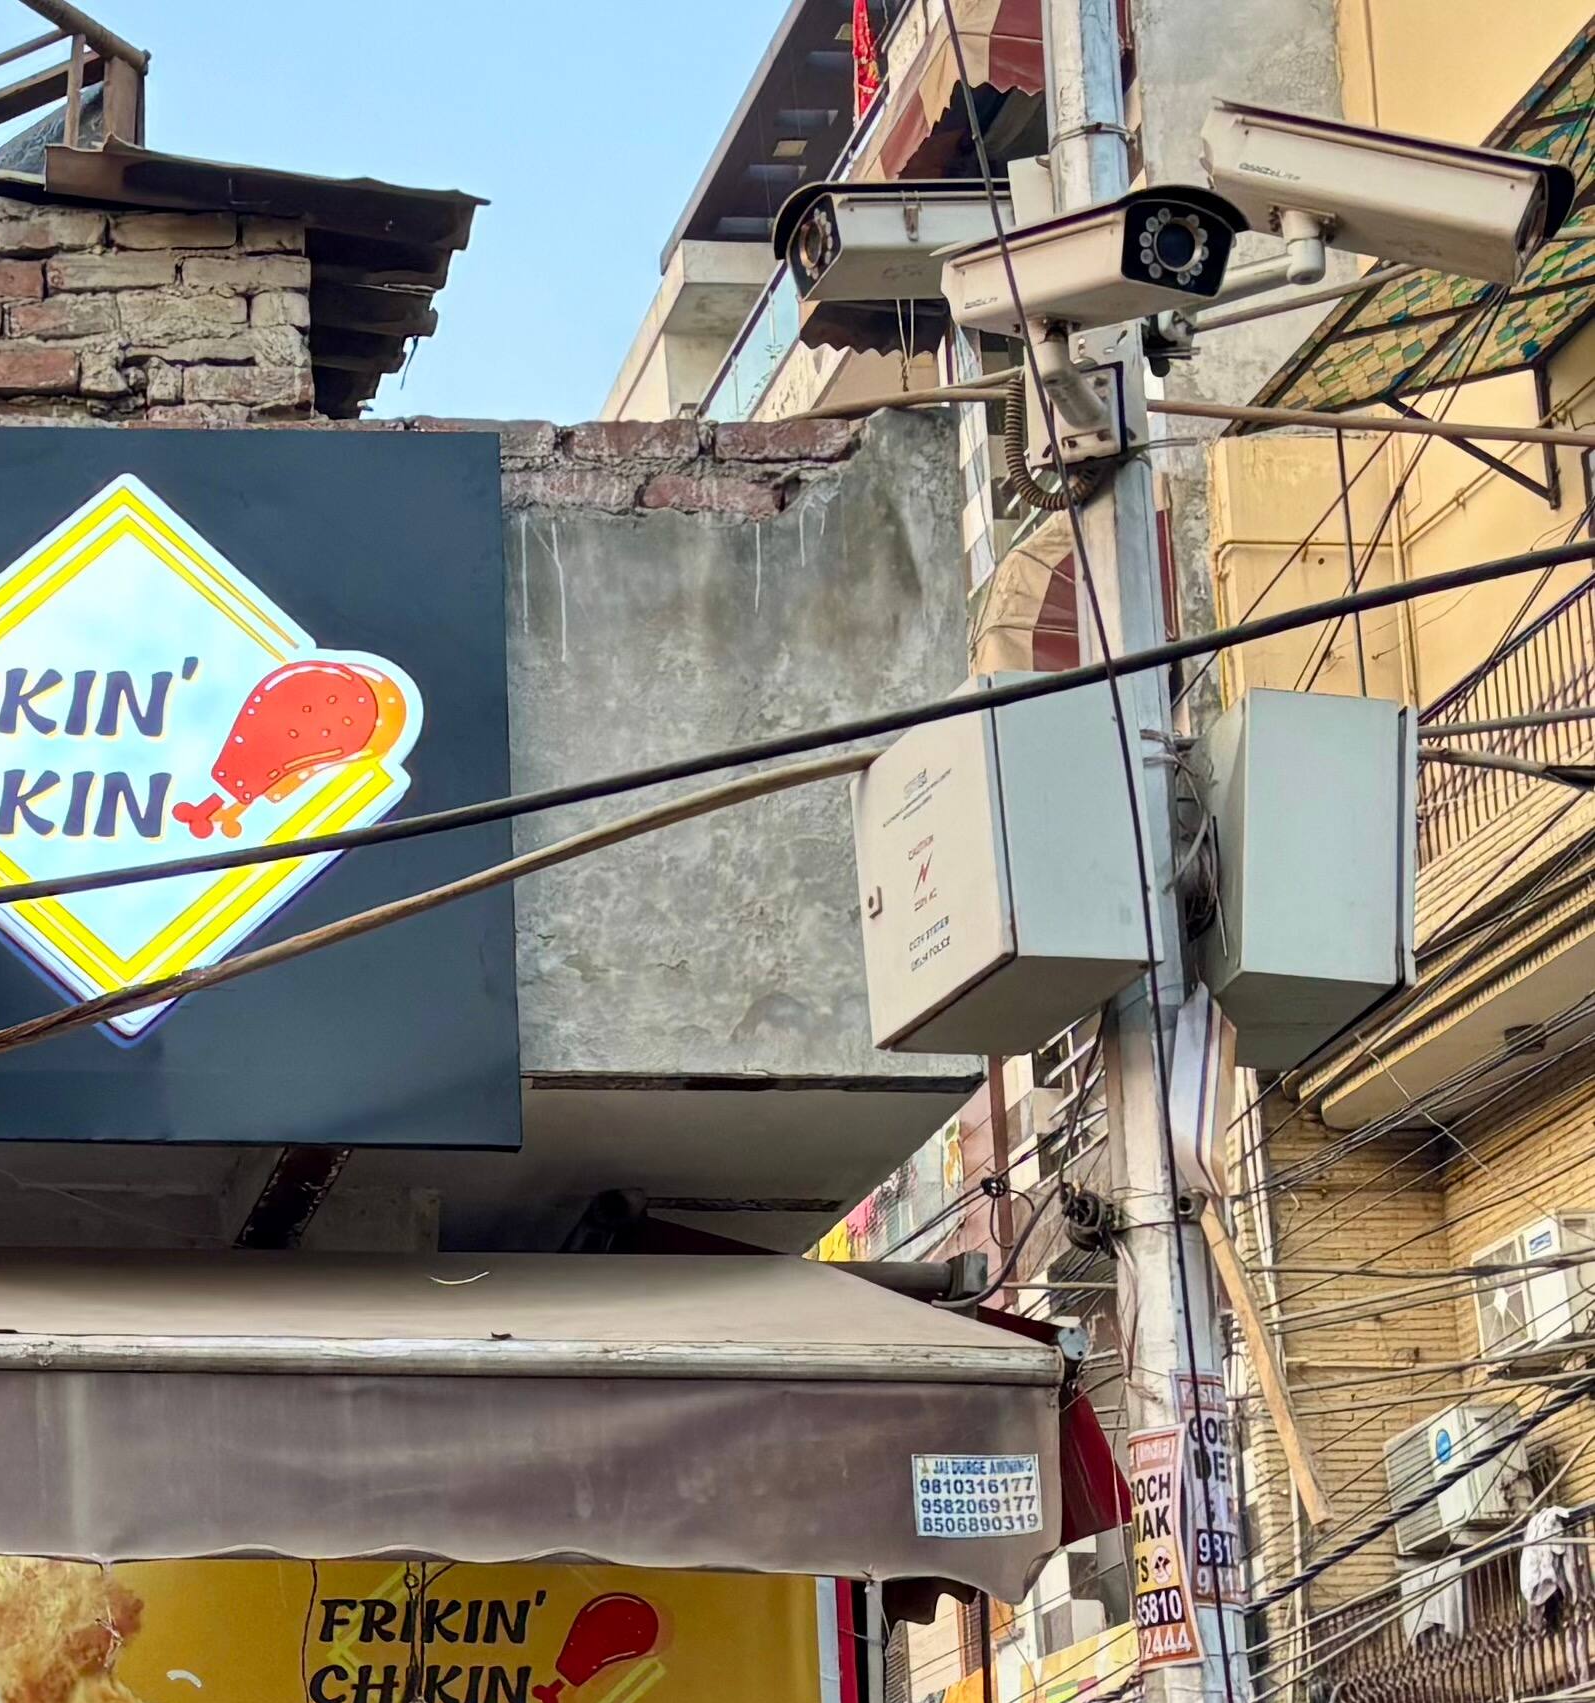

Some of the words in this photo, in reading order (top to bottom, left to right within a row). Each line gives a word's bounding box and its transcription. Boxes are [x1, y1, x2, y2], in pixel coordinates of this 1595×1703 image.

[919, 1476, 1034, 1495] 9810316177
[921, 1495, 1036, 1515] 9582069177
[923, 1513, 1039, 1533] 8506890319
[319, 1589, 547, 1644] FRIKIN'
